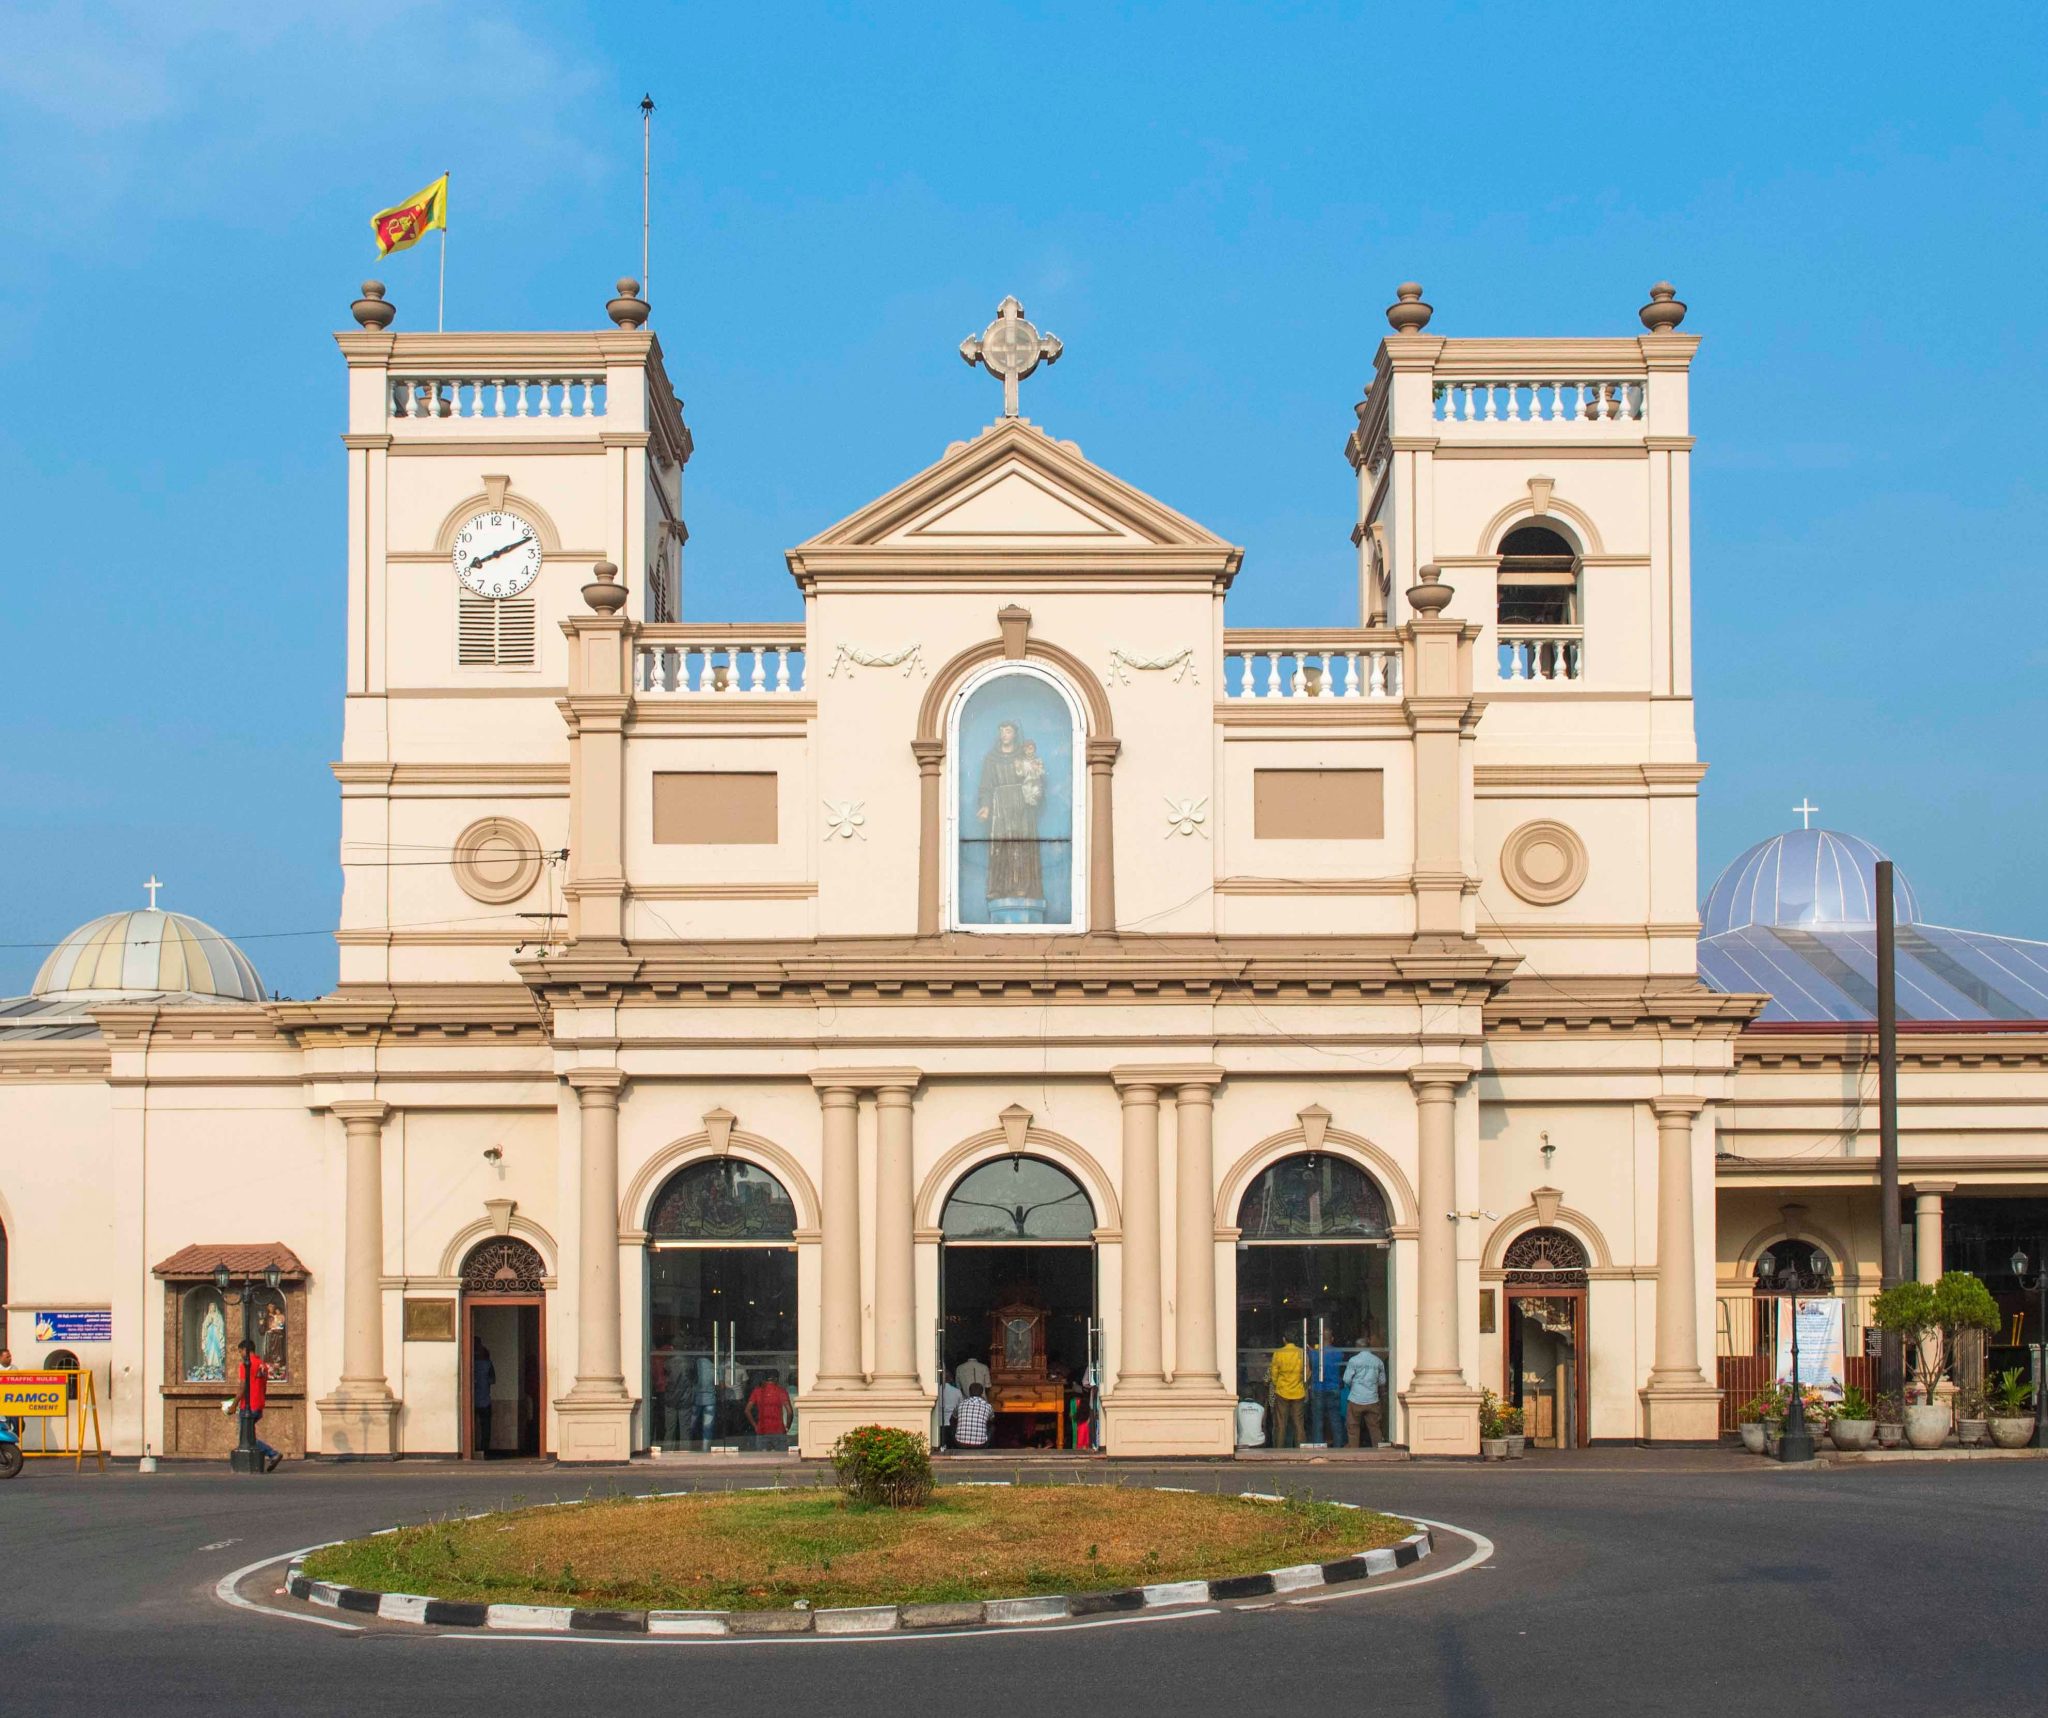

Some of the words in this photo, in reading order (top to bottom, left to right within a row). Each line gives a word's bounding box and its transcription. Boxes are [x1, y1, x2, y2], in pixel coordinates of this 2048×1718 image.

[476, 520, 482, 530] 11
[491, 516, 501, 526] 12
[461, 533, 472, 542] 10
[458, 550, 467, 560] 9
[527, 549, 536, 559] 3
[463, 567, 471, 576] 8
[521, 565, 530, 575] 4
[477, 580, 485, 589] 7
[493, 583, 502, 593] 6
[509, 580, 517, 590] 5
[5, 1393, 59, 1402] RAMCO
